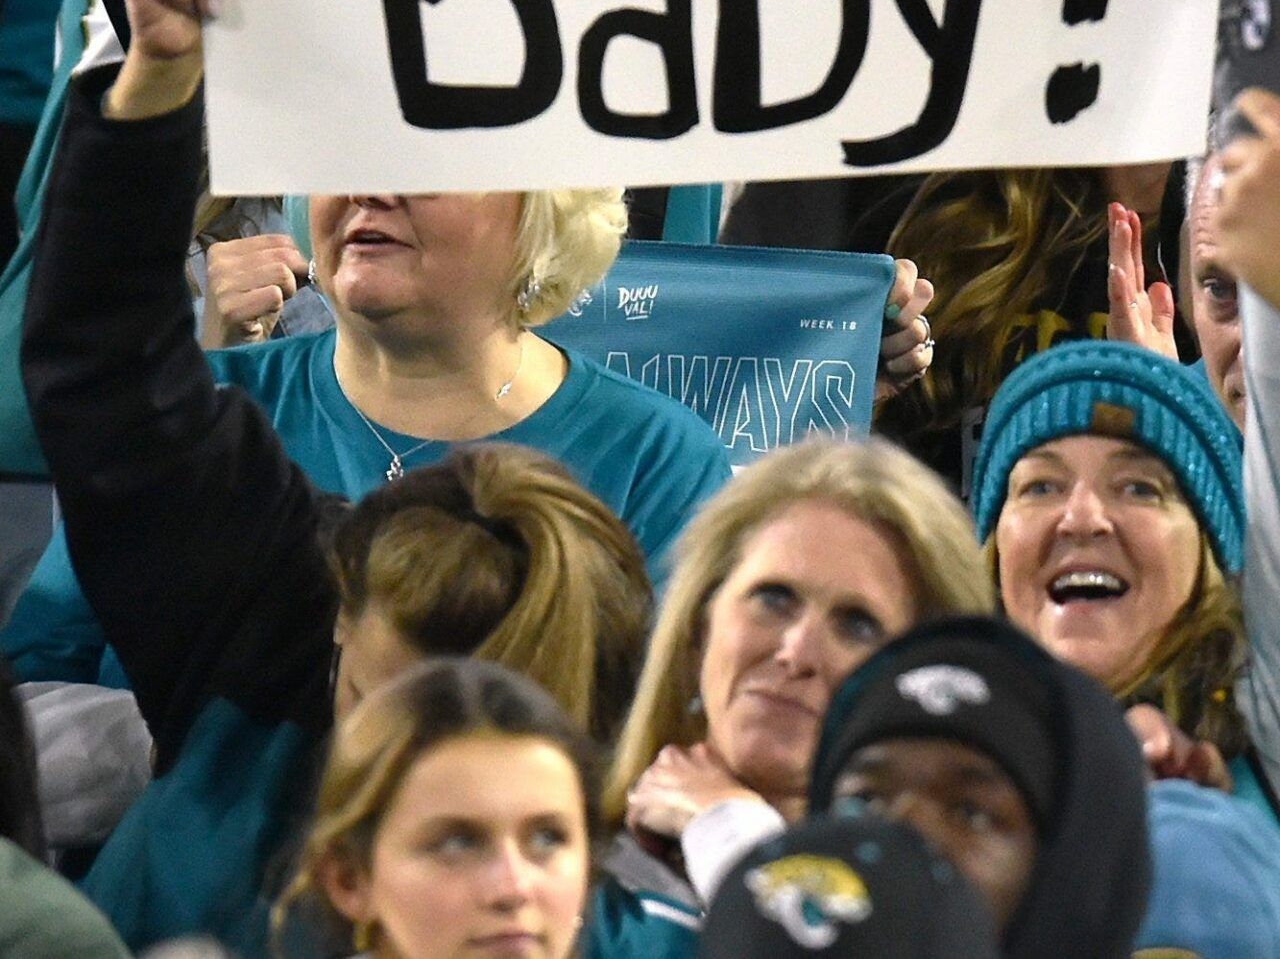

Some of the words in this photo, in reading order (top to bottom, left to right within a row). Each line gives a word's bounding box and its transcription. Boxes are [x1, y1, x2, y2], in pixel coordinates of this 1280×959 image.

[617, 285, 659, 310] DUUU
[624, 301, 653, 315] VAL!
[799, 318, 835, 331] WEEK
[842, 321, 857, 331] 18
[605, 352, 856, 452] WAYS
